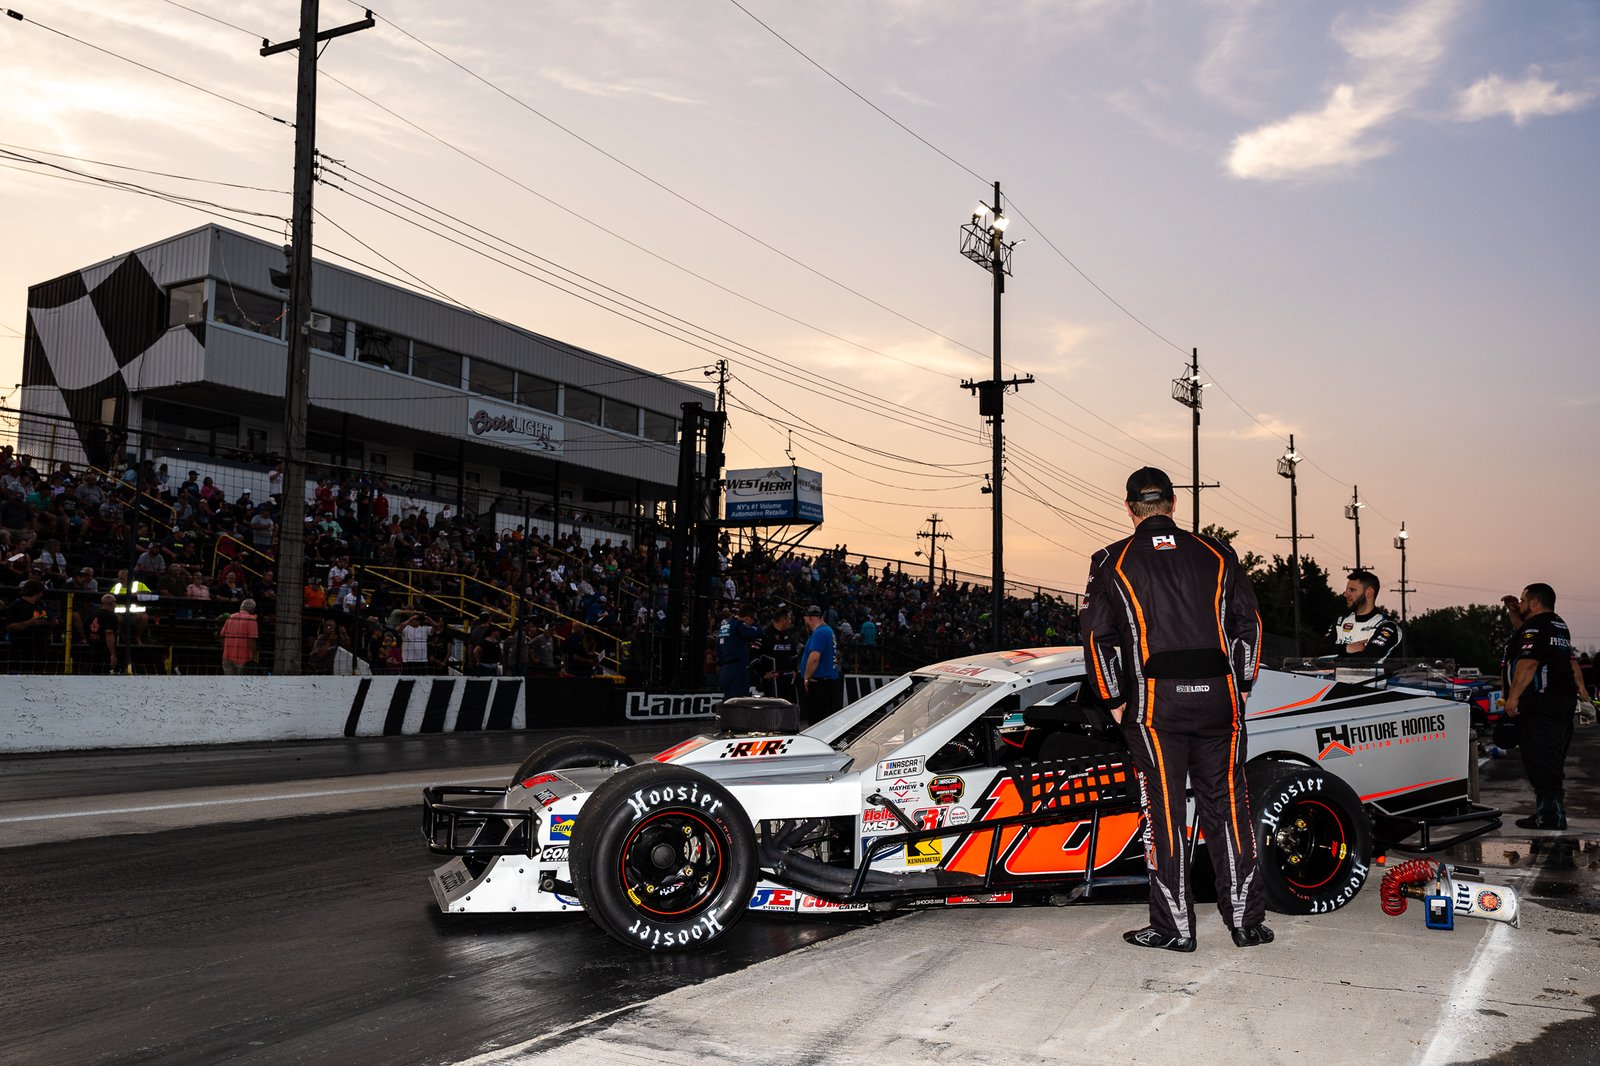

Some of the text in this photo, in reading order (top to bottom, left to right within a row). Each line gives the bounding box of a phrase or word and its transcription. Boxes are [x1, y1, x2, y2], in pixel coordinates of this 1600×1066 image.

[470, 409, 553, 439] Coors LIGHT
[727, 479, 793, 492] WEST HERR
[760, 502, 782, 510] Volume
[731, 510, 764, 518] Automotive
[1350, 721, 1399, 745] FUTURE
[1401, 714, 1446, 737] HOMES
[1352, 732, 1447, 752] CUSTOM BUILDERS
[892, 758, 919, 769] NASCAR
[883, 767, 917, 777] RACE CAR
[889, 783, 918, 792] MAYHEW
[627, 784, 723, 821] Hoosier
[1261, 777, 1324, 833] Hoosier
[553, 824, 575, 832] SUN
[862, 820, 899, 832] MSD
[907, 856, 941, 865] KENNAMETAL
[1310, 861, 1368, 913] Hoosier
[750, 889, 793, 909] JE
[628, 908, 723, 949] Hoosier
